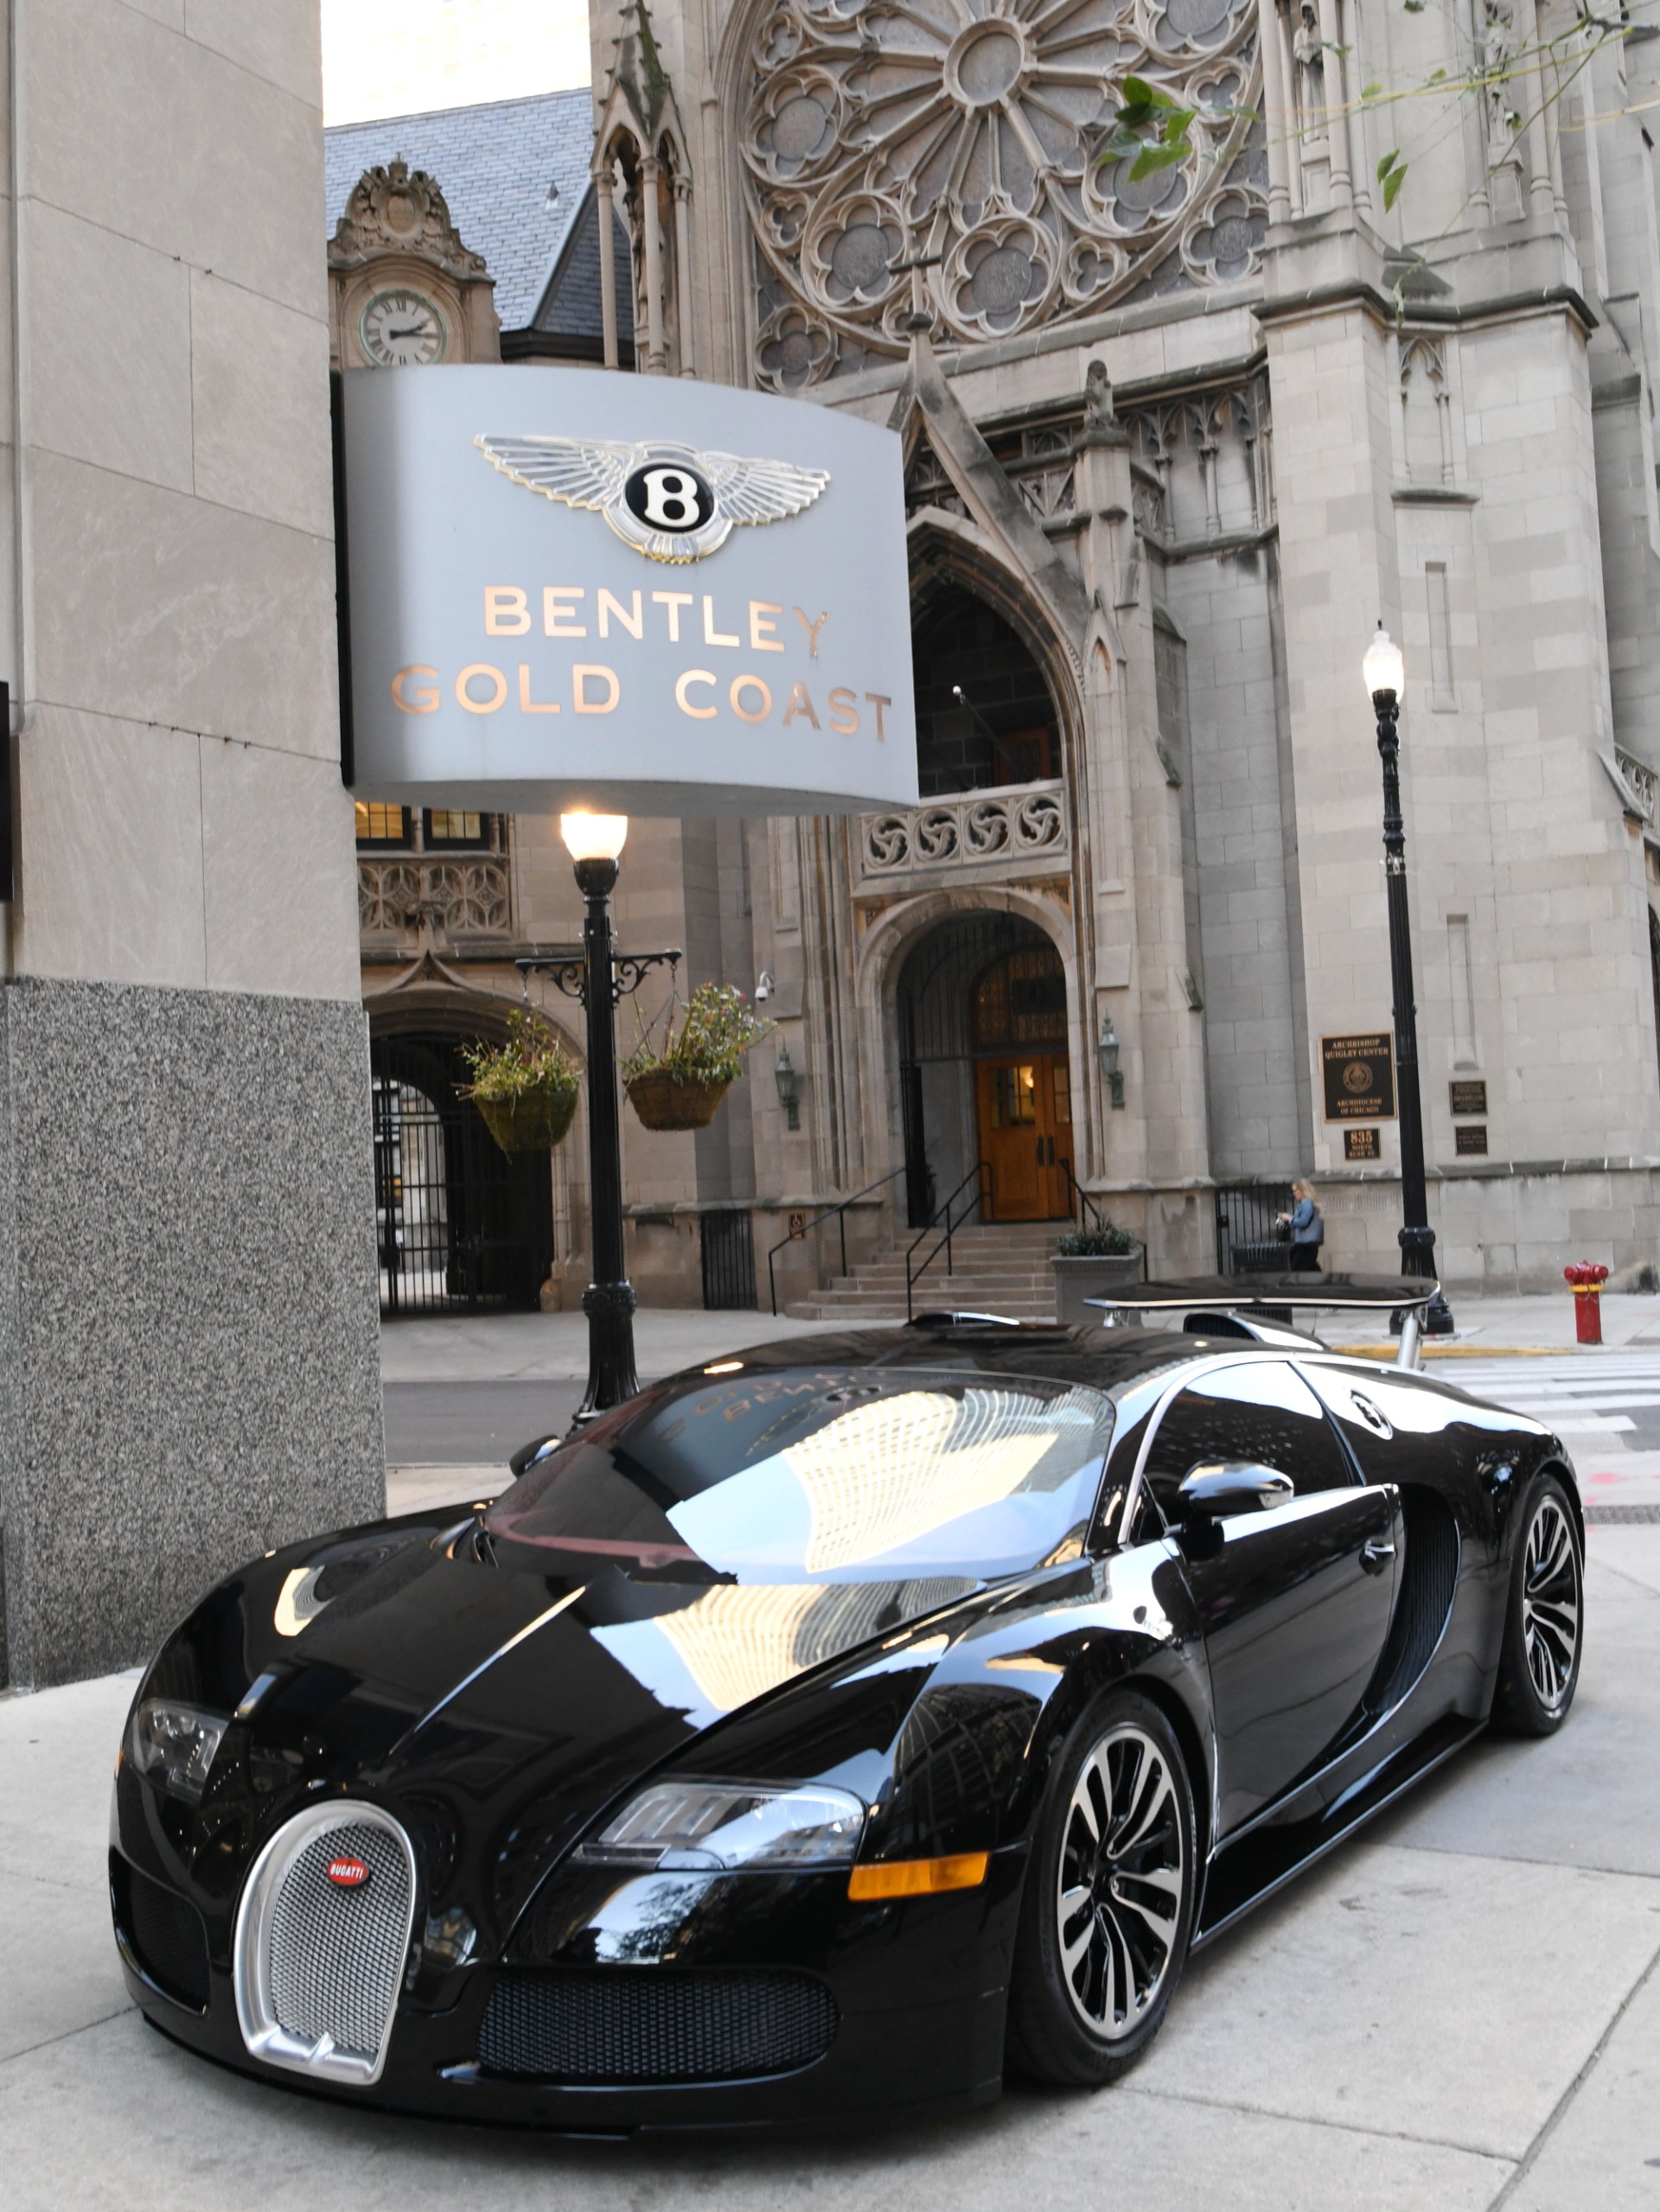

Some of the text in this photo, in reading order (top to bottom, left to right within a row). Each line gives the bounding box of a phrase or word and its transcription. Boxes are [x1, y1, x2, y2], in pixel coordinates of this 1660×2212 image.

[642, 468, 699, 527] B
[484, 585, 830, 657] BENTLEY
[391, 663, 892, 741] GOLD COAST
[1331, 1038, 1381, 1049] ARCHBISHOP
[1325, 1046, 1389, 1060] QUIGLEY CENTER
[1337, 1098, 1382, 1107] ARCHDIOCESE
[1350, 1106, 1379, 1114] CHICAGO
[1350, 1130, 1373, 1144] 835
[330, 1863, 364, 1879] BUGATTI
